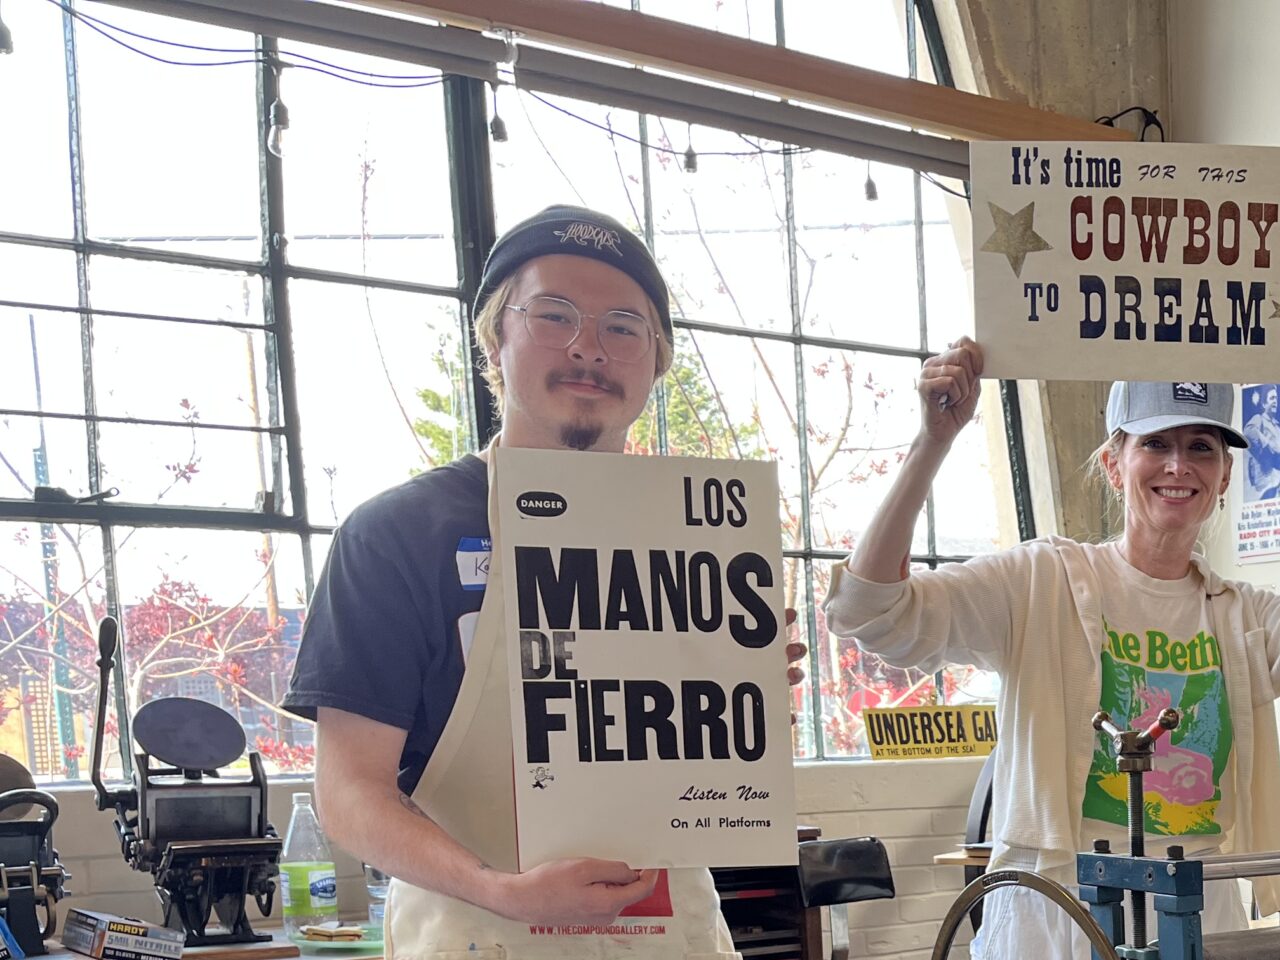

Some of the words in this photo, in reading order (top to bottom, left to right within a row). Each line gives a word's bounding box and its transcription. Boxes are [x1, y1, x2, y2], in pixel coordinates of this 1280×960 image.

[1011, 147, 1050, 185] It's
[1064, 147, 1121, 188] time
[1138, 164, 1176, 182] FOR
[1198, 167, 1248, 183] THIS
[1070, 195, 1279, 268] COWBOY
[1024, 282, 1059, 322] TO
[1079, 275, 1266, 346] DREAM
[520, 499, 563, 510] DANGER
[683, 477, 748, 528] LOS
[1239, 530, 1257, 540] RADIO
[1258, 529, 1271, 538] CITY
[514, 546, 778, 649] MANOS
[519, 631, 578, 680] DE
[523, 679, 766, 763] FIERRO
[868, 711, 967, 745] UNDERSEA
[876, 749, 884, 757] AT
[886, 748, 900, 756] THE
[902, 747, 932, 756] BOTTOM
[935, 746, 944, 755] OF
[945, 746, 959, 754] THE
[679, 785, 728, 802] Listen
[736, 785, 770, 801] Now
[671, 818, 688, 829] On
[695, 817, 711, 828] All
[719, 817, 771, 828] Platforms
[109, 922, 146, 936] HARDY
[529, 924, 666, 936] WWW.THECOMPOUNDGALLERY.COM
[135, 938, 181, 954] NITRILE
